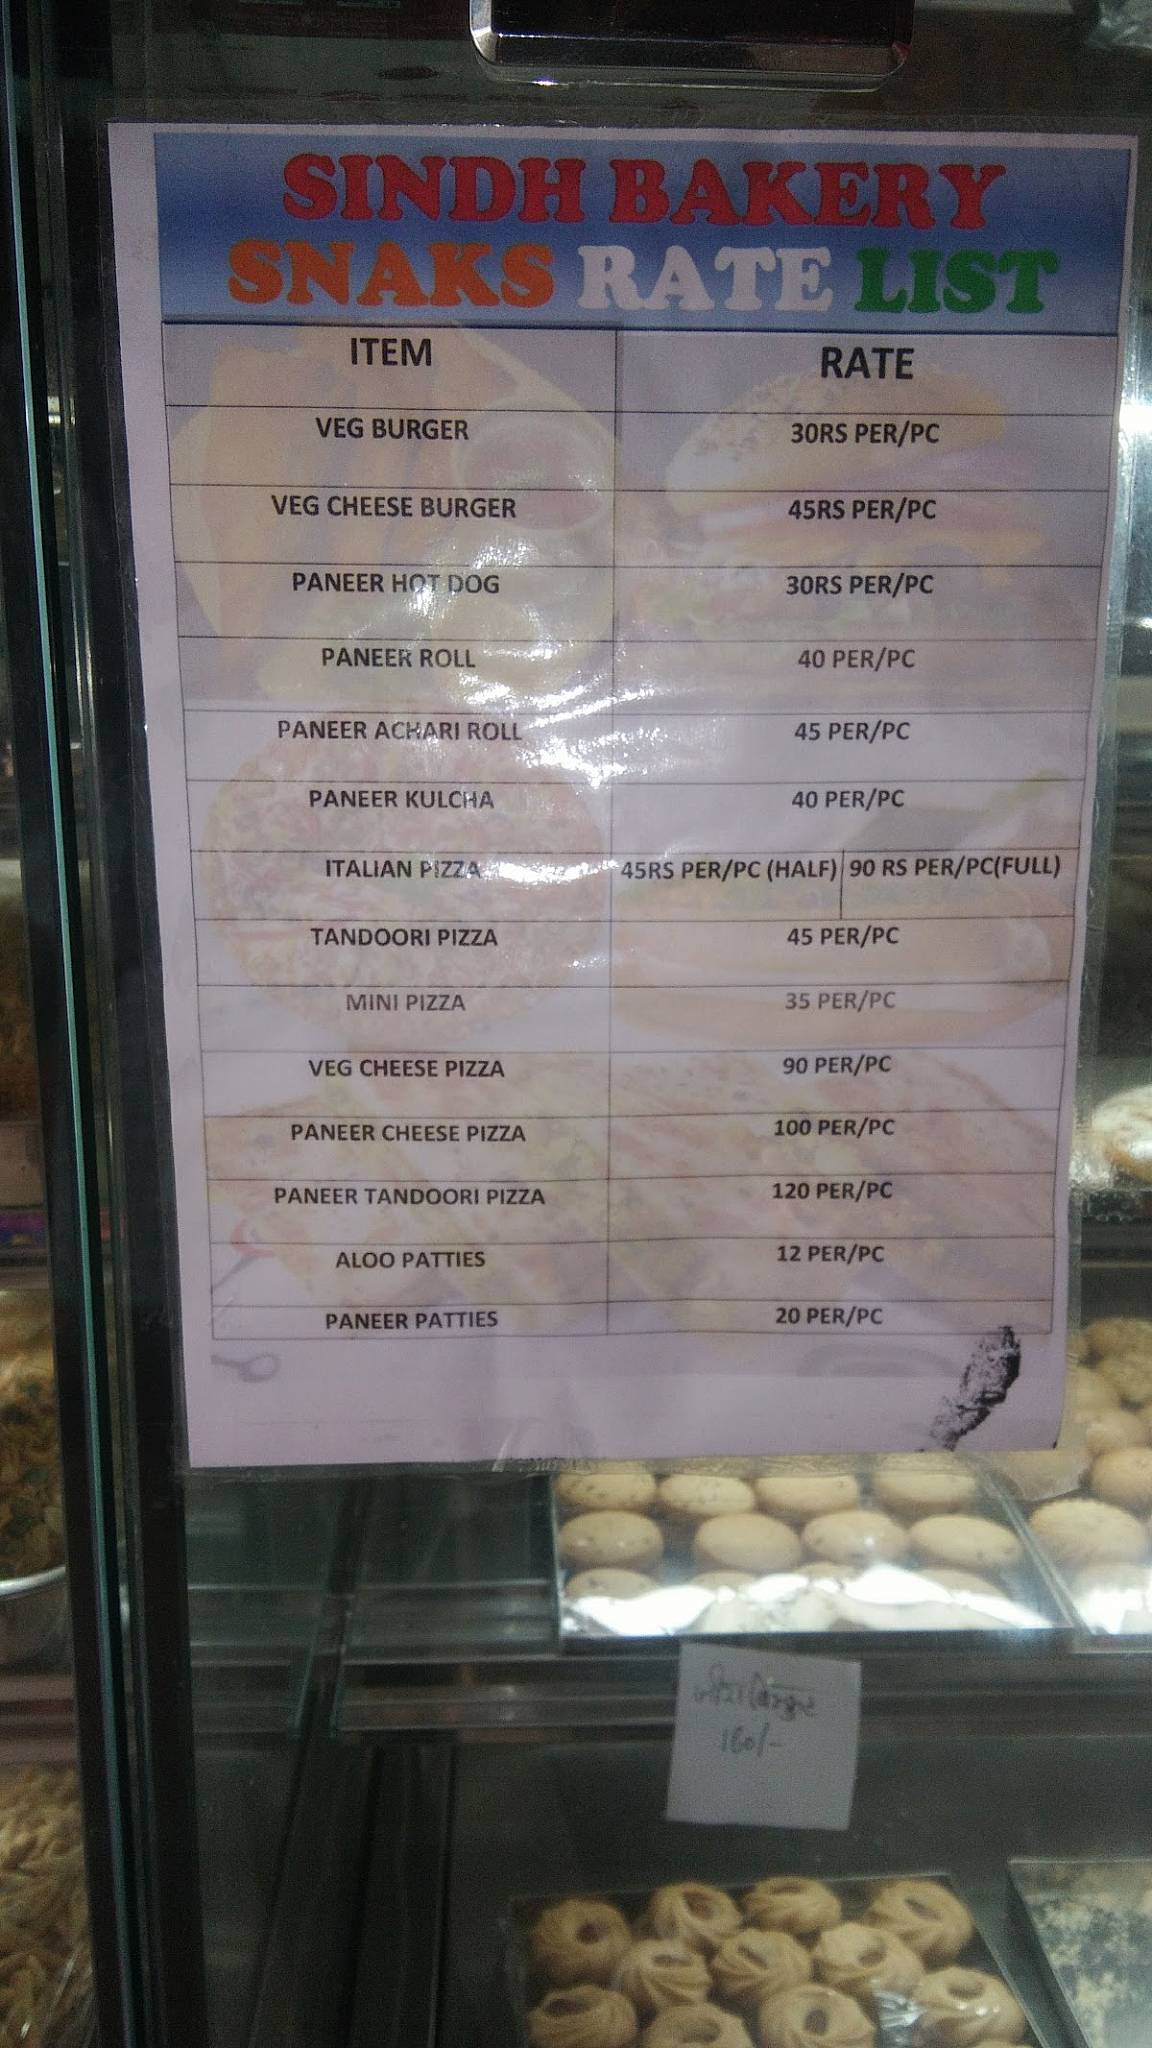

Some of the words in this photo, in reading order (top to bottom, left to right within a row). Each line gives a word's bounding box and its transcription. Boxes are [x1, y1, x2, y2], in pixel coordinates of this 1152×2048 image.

[283, 154, 586, 223] SINDH
[609, 159, 1006, 229] BAKERY
[228, 239, 555, 307] SNAKS
[577, 245, 833, 312] RATE
[853, 248, 1061, 314] LIST
[351, 338, 432, 367] ITEM
[820, 347, 914, 380] RATE
[316, 418, 364, 439] VEG
[372, 419, 469, 440] BURGER
[791, 423, 847, 444] 30RS
[855, 420, 939, 448] PER/PC
[272, 495, 319, 516] VEG
[327, 497, 413, 517] CHEESE
[421, 498, 516, 519] BURGER
[788, 499, 845, 520] 45RS
[852, 498, 937, 523] PER/PC
[292, 572, 384, 592] PANEER
[392, 573, 439, 593] HOT
[448, 574, 499, 594] DOG
[786, 574, 841, 595] 30RS
[849, 574, 933, 598] PER/PC
[321, 648, 411, 667] PANEER
[420, 649, 475, 668] ROLL
[798, 649, 825, 669] 40
[833, 648, 915, 672] PER/PC
[278, 720, 367, 739] PANEER
[374, 721, 459, 740] ACHARI
[467, 722, 522, 741] ROLL
[795, 723, 821, 741] 45
[828, 721, 910, 743] PER/PC
[309, 790, 398, 808] PANEER
[405, 790, 495, 809] KULCHA
[791, 790, 818, 808] 40
[826, 789, 904, 811] PER/PC
[325, 860, 412, 878] ITALIAN
[420, 860, 481, 878] PIZZA
[621, 861, 674, 880] 45RS
[681, 860, 761, 882] PER/PC
[767, 859, 837, 882] (HALF)
[849, 859, 876, 876] 90
[882, 859, 907, 876] RS
[311, 928, 430, 946] TANDOORI
[438, 929, 498, 947] PIZZA
[787, 928, 813, 945] 45
[820, 926, 899, 948] PER/PC
[346, 994, 398, 1011] MINI
[406, 994, 465, 1011] PIZZA
[785, 992, 810, 1009] 35
[818, 991, 896, 1012] PER/PC
[309, 1060, 352, 1077] VEG
[359, 1060, 438, 1077] CHEESE
[446, 1060, 505, 1077] PIZZA
[783, 1057, 808, 1074] 90
[815, 1055, 891, 1076] PER/PC
[291, 1124, 375, 1141] PANEER
[381, 1125, 459, 1142] CHEESE
[467, 1125, 526, 1142] PIZZA
[774, 1119, 811, 1136] 100
[818, 1118, 895, 1138] PER/PC
[274, 1187, 357, 1204] PANEER
[364, 1187, 479, 1205] TANDOORI
[487, 1188, 545, 1205] PIZZA
[772, 1183, 810, 1199] 120
[816, 1181, 893, 1202] PER/PC
[336, 1252, 395, 1269] ALOO
[402, 1251, 486, 1268] PATTIES
[777, 1246, 801, 1262] 12
[807, 1244, 884, 1264] PER/PC
[325, 1313, 408, 1330] PANEER
[415, 1311, 498, 1328] PATTIES
[775, 1308, 800, 1324] 20
[807, 1307, 883, 1327] PER/PC
